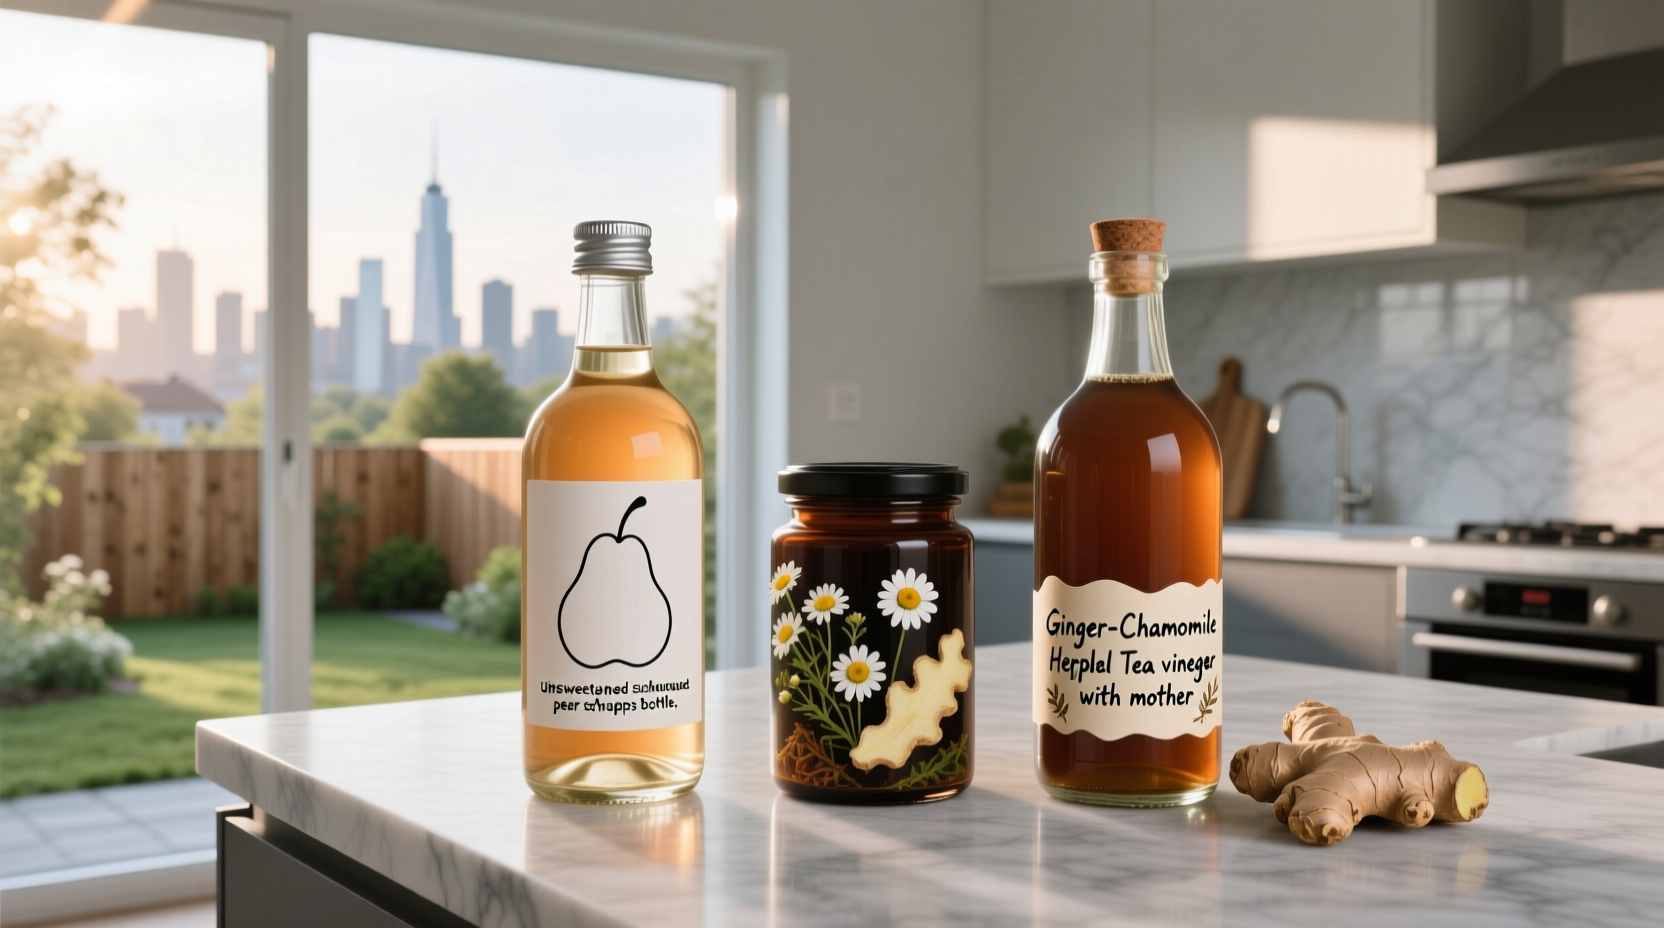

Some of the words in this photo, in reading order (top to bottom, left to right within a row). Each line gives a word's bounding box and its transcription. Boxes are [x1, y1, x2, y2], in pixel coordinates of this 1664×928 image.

[1046, 608, 1216, 649] Ginger-Chamomile
[1120, 650, 1155, 674] Tea
[1080, 682, 1121, 706] with
[1130, 683, 1194, 706] mother
